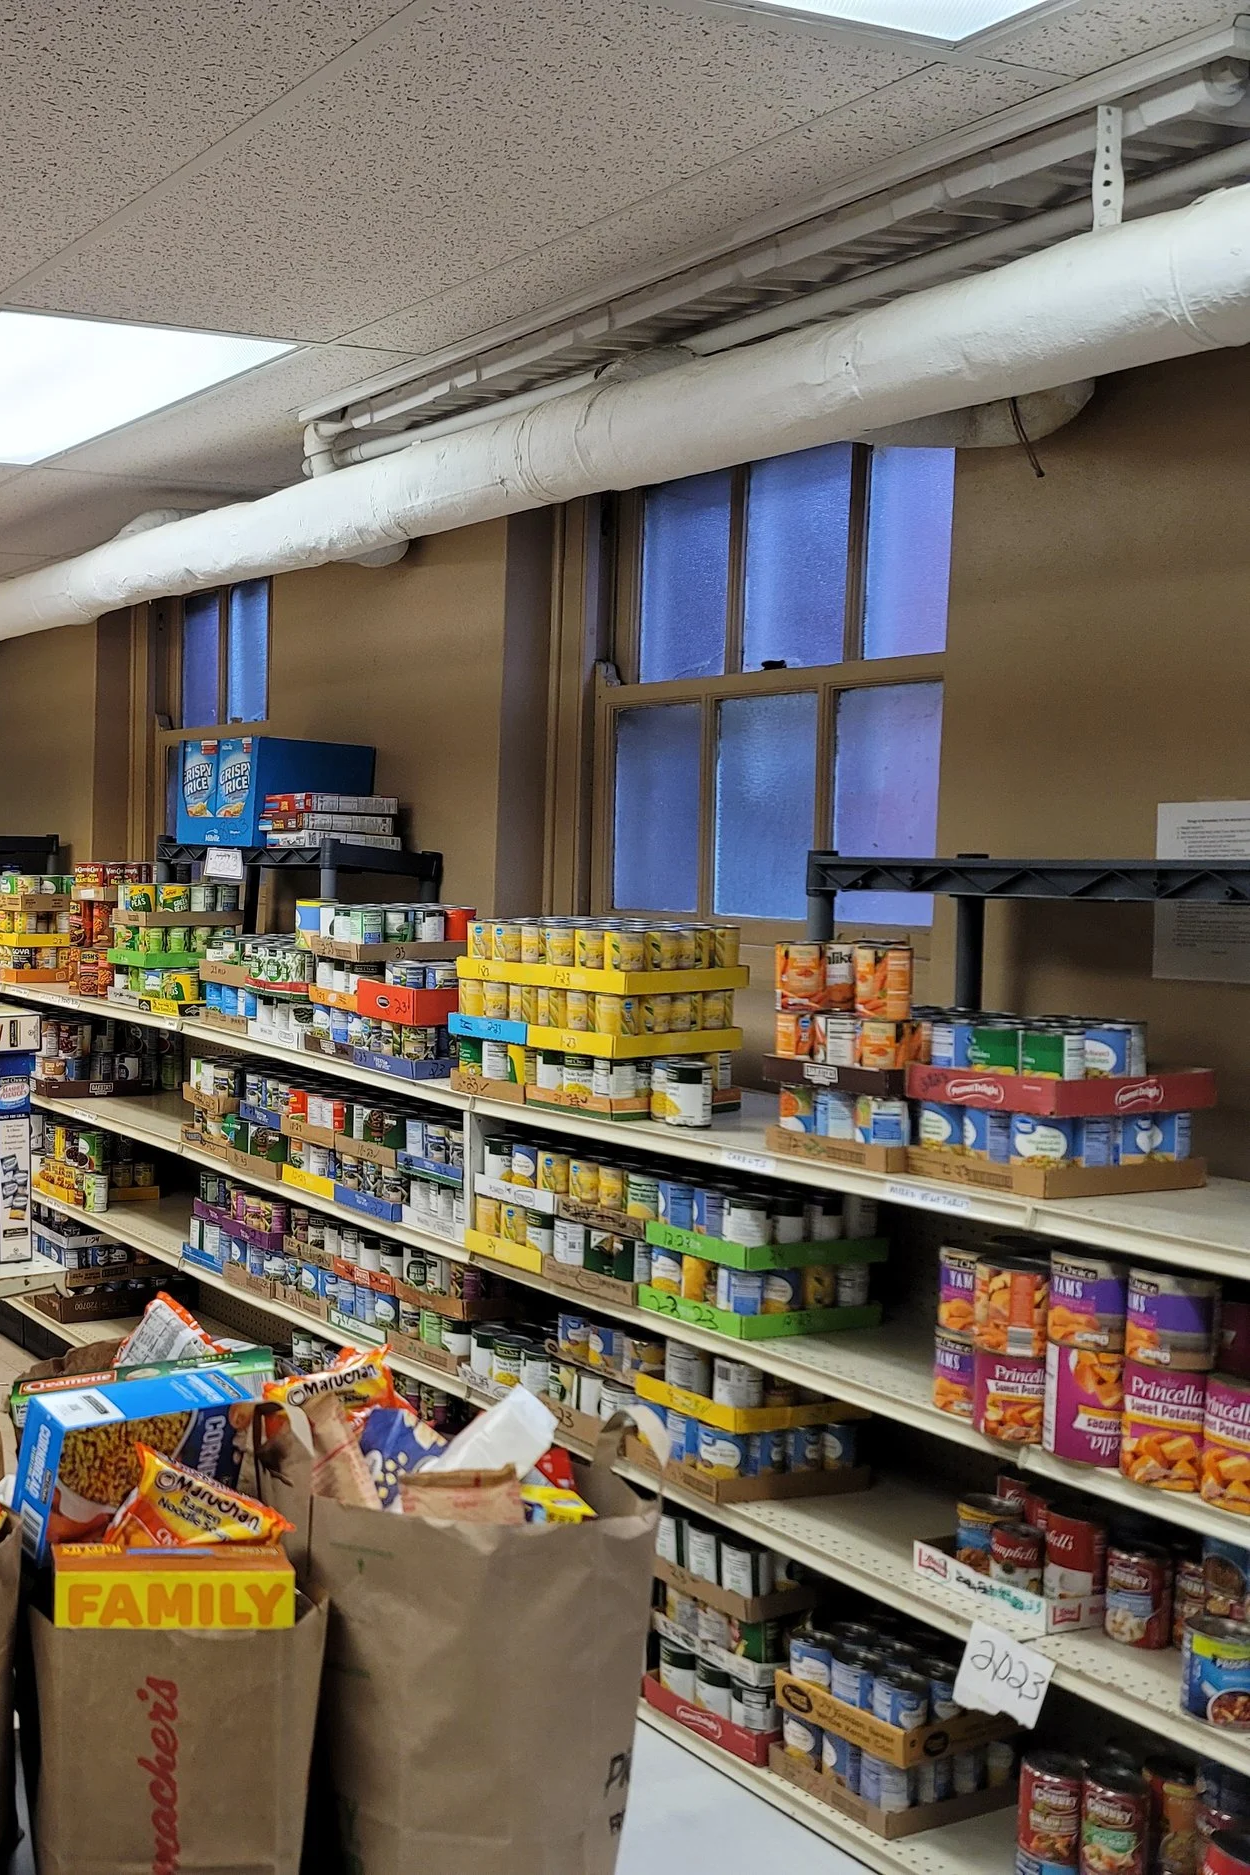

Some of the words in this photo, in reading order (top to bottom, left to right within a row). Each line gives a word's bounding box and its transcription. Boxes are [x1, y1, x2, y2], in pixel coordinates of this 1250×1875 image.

[184, 762, 213, 784] CRISPY
[219, 761, 251, 786] CRISPY
[187, 777, 209, 796] RICE
[225, 776, 249, 796] RICE
[10, 1076, 27, 1084] Choice
[949, 1272, 974, 1290] YAM
[1053, 1278, 1083, 1298] YAMS
[25, 1372, 112, 1392] Creamette
[302, 1362, 377, 1398] Maruchan
[994, 1365, 1046, 1383] Princell
[994, 1383, 1019, 1395] Sweet
[1020, 1384, 1046, 1396] Potato
[1131, 1376, 1203, 1405] Princella
[157, 1497, 201, 1527] Noodle
[176, 1472, 260, 1532] Maruchan
[180, 1496, 221, 1525] Ramen
[67, 1582, 288, 1627] FAMILY
[137, 1676, 180, 1875] macher's
